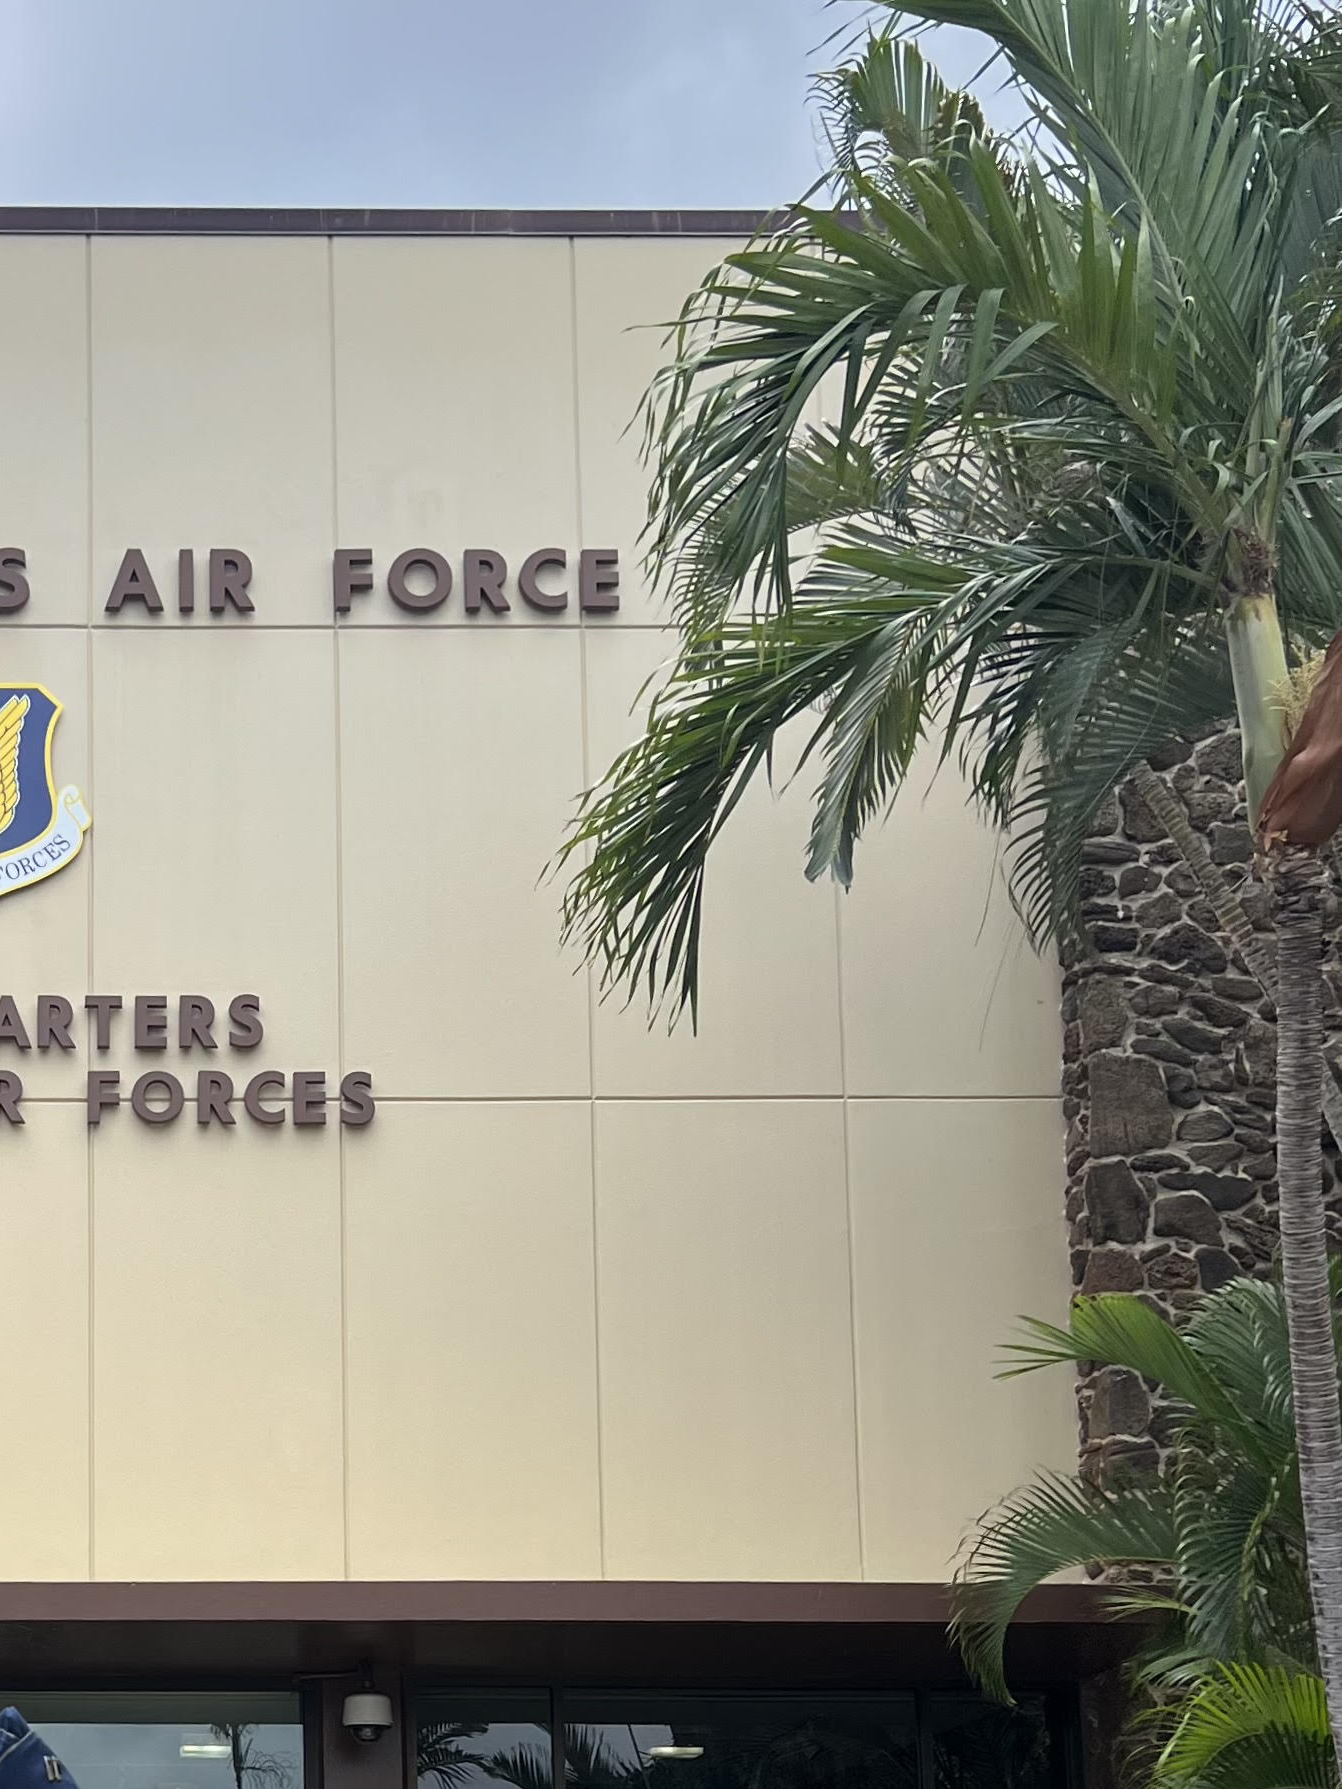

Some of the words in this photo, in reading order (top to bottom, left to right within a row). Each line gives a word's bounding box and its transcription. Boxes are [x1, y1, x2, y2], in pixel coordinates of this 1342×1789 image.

[104, 547, 256, 614] AIR
[332, 547, 621, 614] FORCE
[86, 1070, 377, 1126] FORCES
